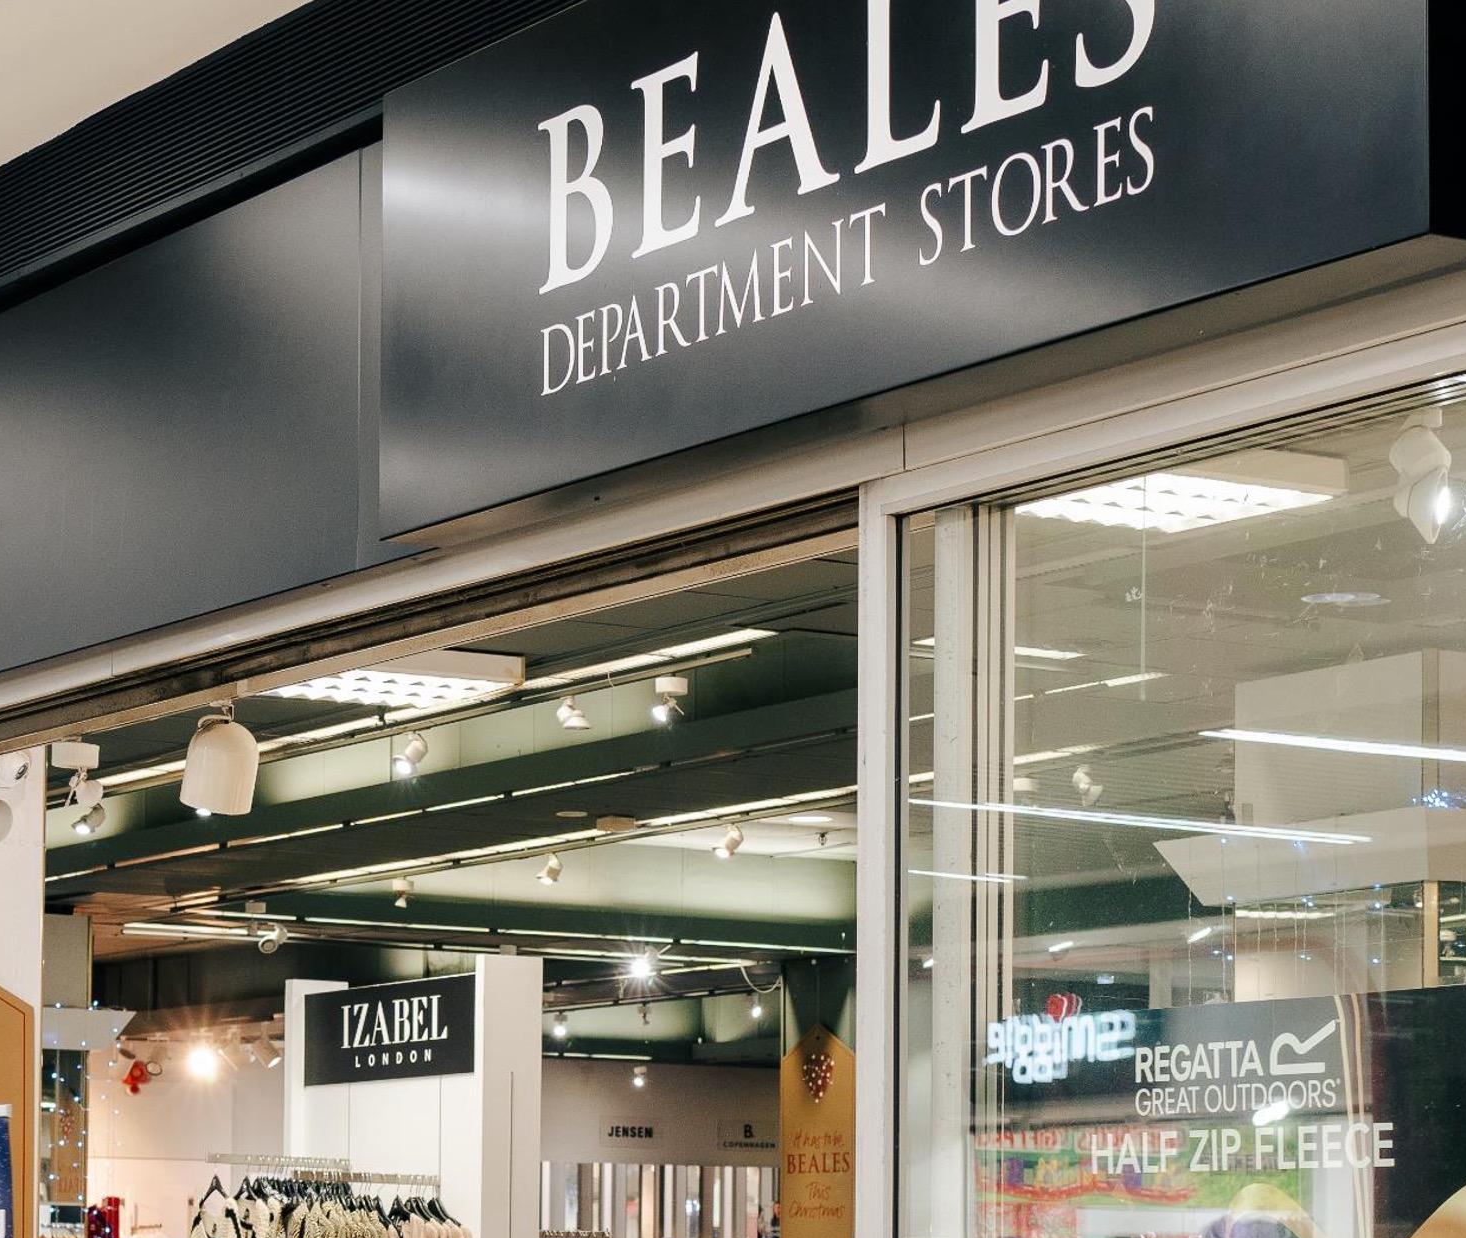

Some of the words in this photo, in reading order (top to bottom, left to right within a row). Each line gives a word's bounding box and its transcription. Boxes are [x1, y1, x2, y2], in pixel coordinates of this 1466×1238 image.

[539, 202, 886, 397] DEPARTMENT
[917, 106, 1155, 266] STORES
[341, 994, 448, 1049] IZABEL
[355, 1048, 432, 1068] LONDON
[1135, 1040, 1264, 1083] REGATTA
[1135, 1086, 1200, 1116] GREAT
[607, 1126, 654, 1139] JENSEN
[1090, 1130, 1178, 1176] HALF
[1189, 1128, 1242, 1172] ZIP
[1254, 1122, 1396, 1170] FLEECE
[787, 1152, 850, 1174] BEALES
